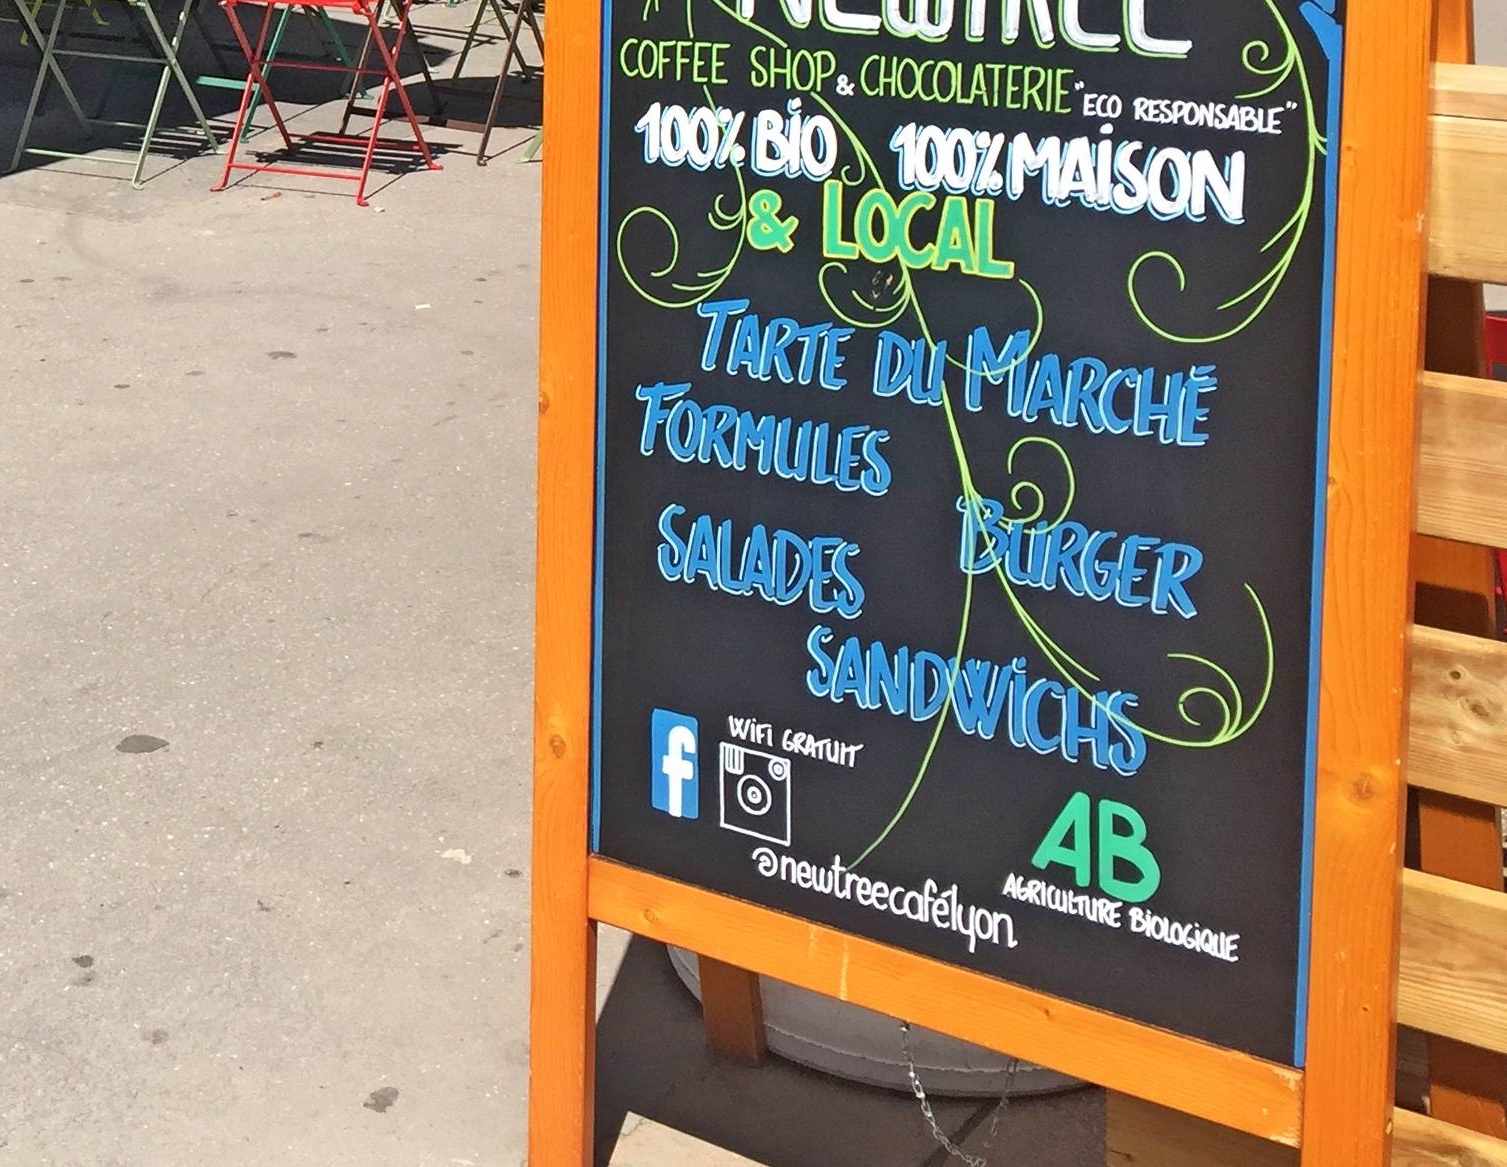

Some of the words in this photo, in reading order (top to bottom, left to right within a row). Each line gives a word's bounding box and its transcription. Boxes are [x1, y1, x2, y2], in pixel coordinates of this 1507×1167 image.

[620, 38, 731, 84] COFFEE
[750, 45, 836, 92] SHOP
[836, 73, 855, 97] &
[860, 54, 1074, 114] CHOCOLATERIE
[635, 101, 746, 171] 100%
[890, 122, 1004, 196] 100%
[746, 188, 799, 253] &
[822, 179, 1016, 280] LOCAL
[697, 299, 856, 391] TARTE
[873, 329, 948, 406] DU
[635, 382, 893, 497] FORMULES
[657, 503, 866, 620] SALADES
[955, 496, 1204, 620] BURGER
[782, 727, 865, 769] GRATUIT
[1031, 790, 1161, 903] AB
